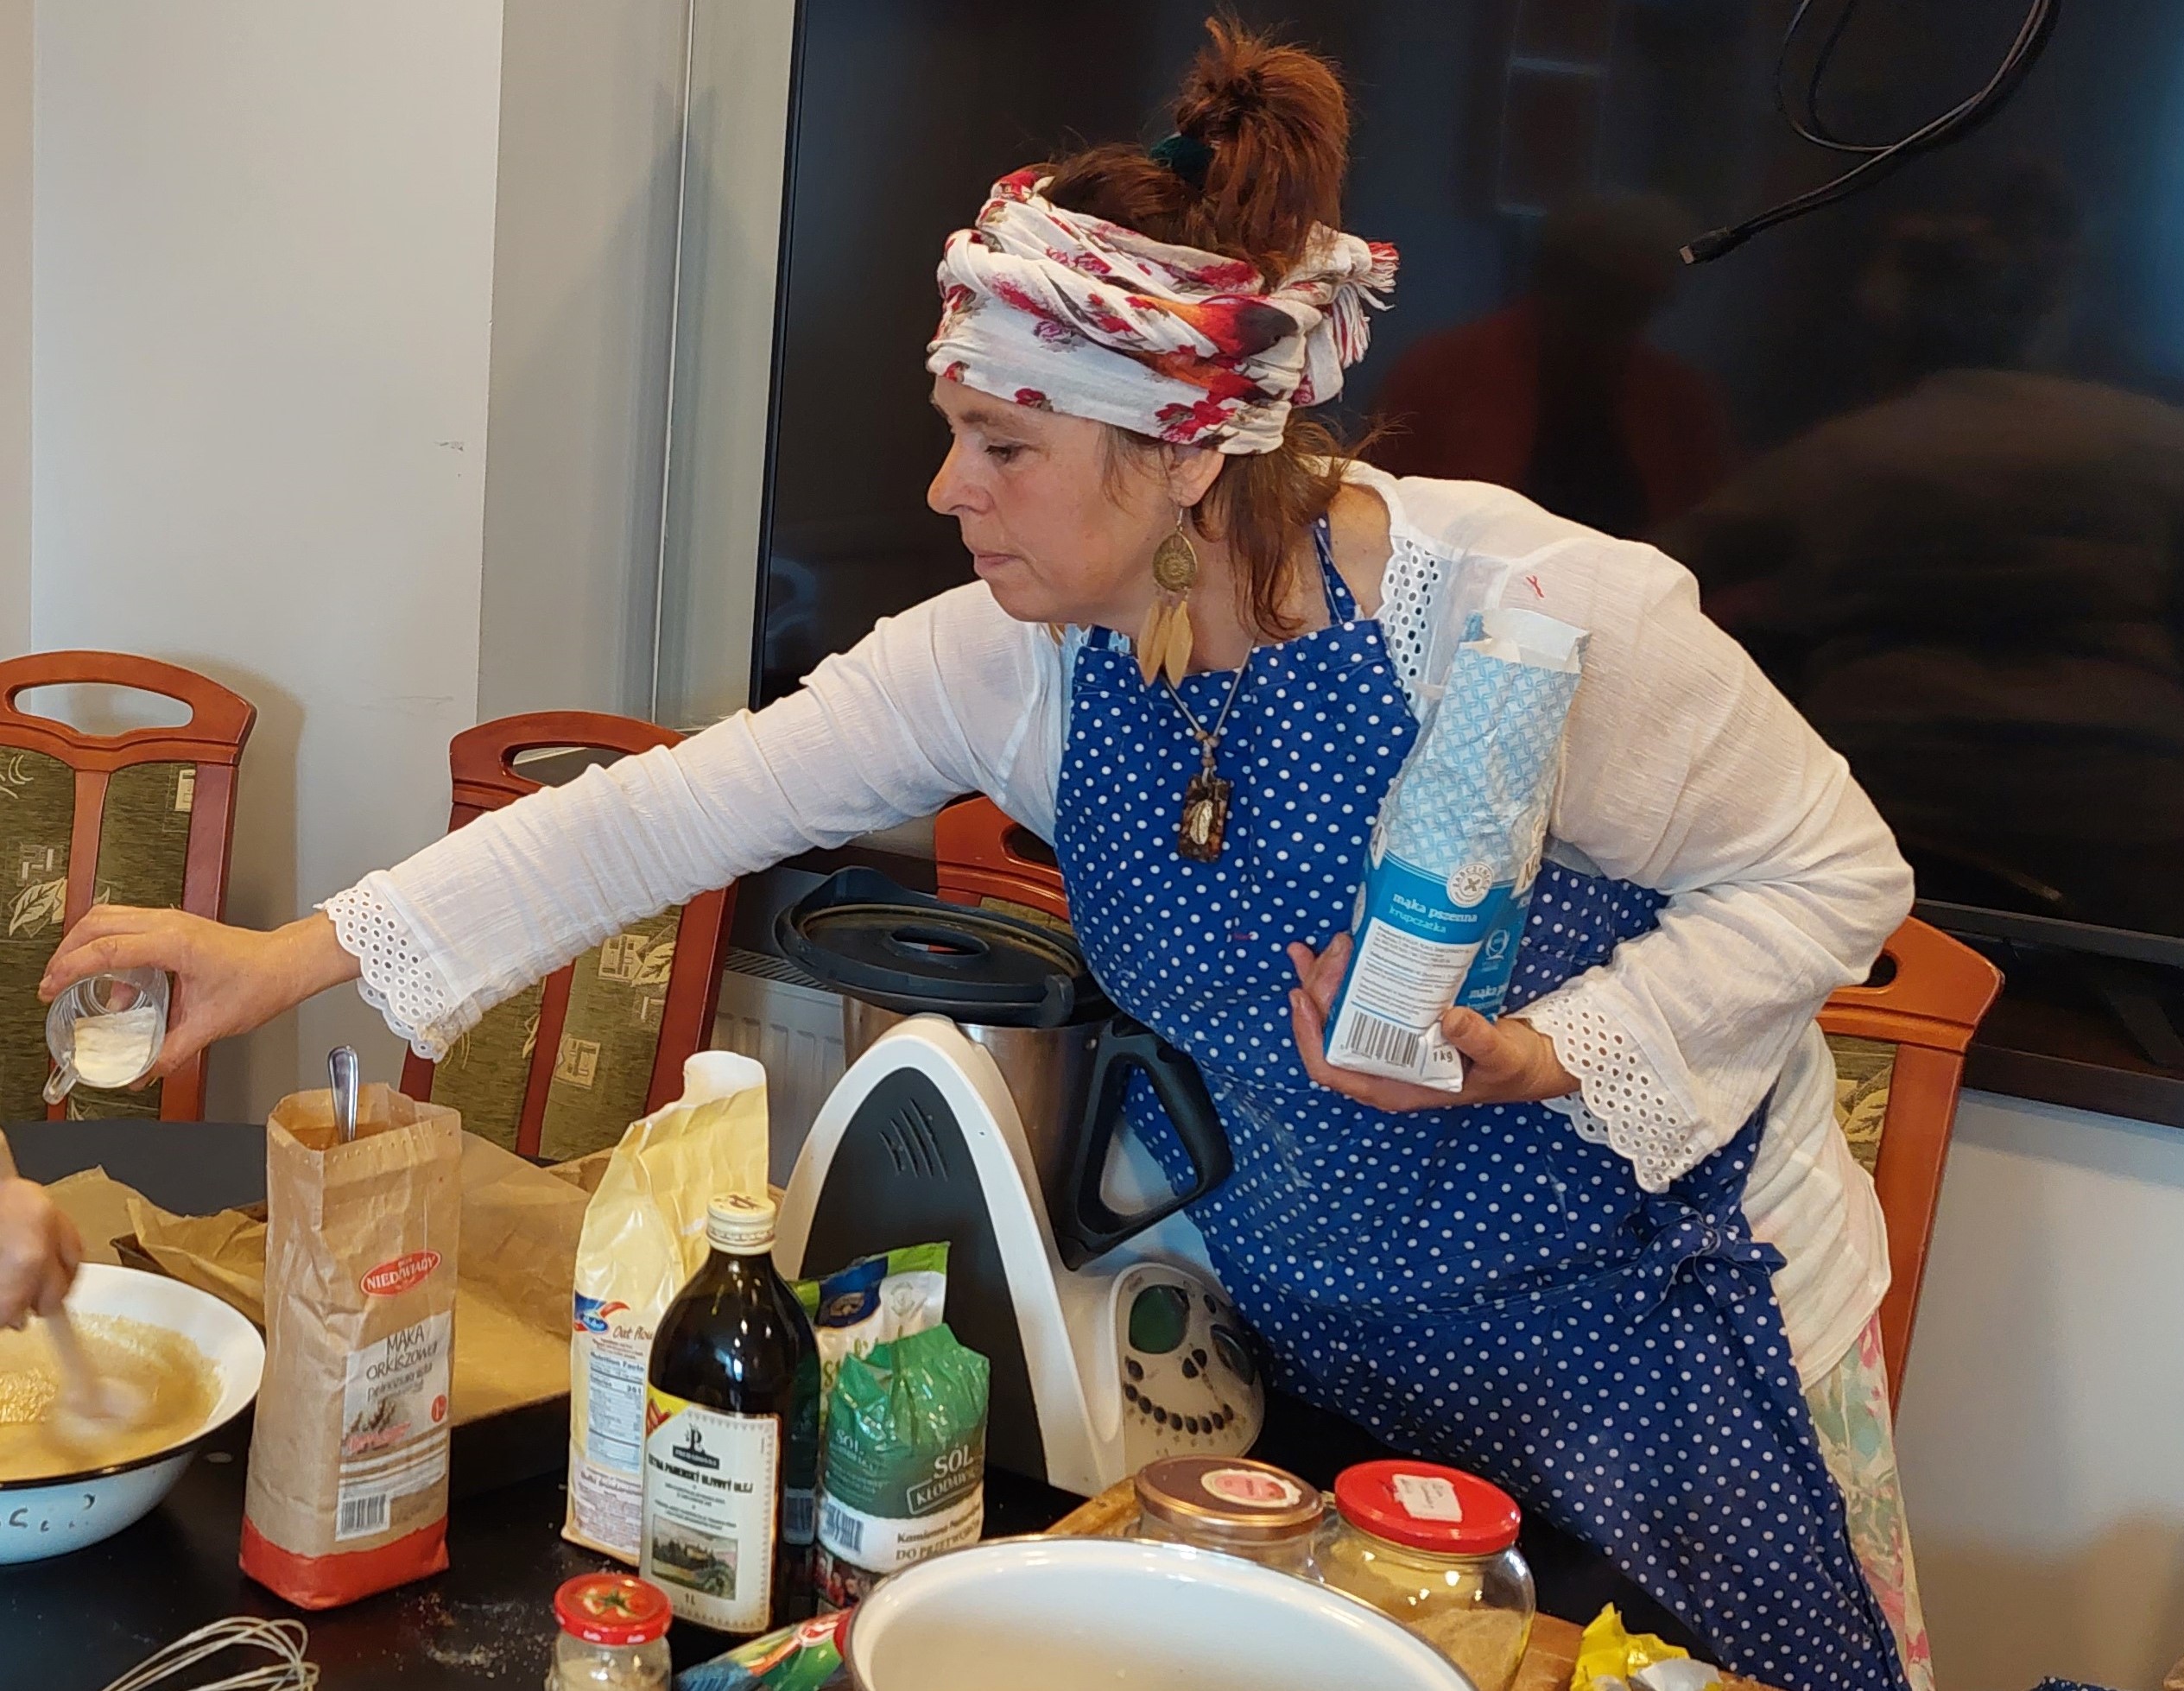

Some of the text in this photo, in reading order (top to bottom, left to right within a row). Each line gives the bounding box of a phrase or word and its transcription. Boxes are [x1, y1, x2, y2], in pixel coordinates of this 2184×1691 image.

[1393, 893, 1427, 913] mąka
[1440, 1050, 1453, 1062] kg
[934, 1441, 974, 1479] SÓL
